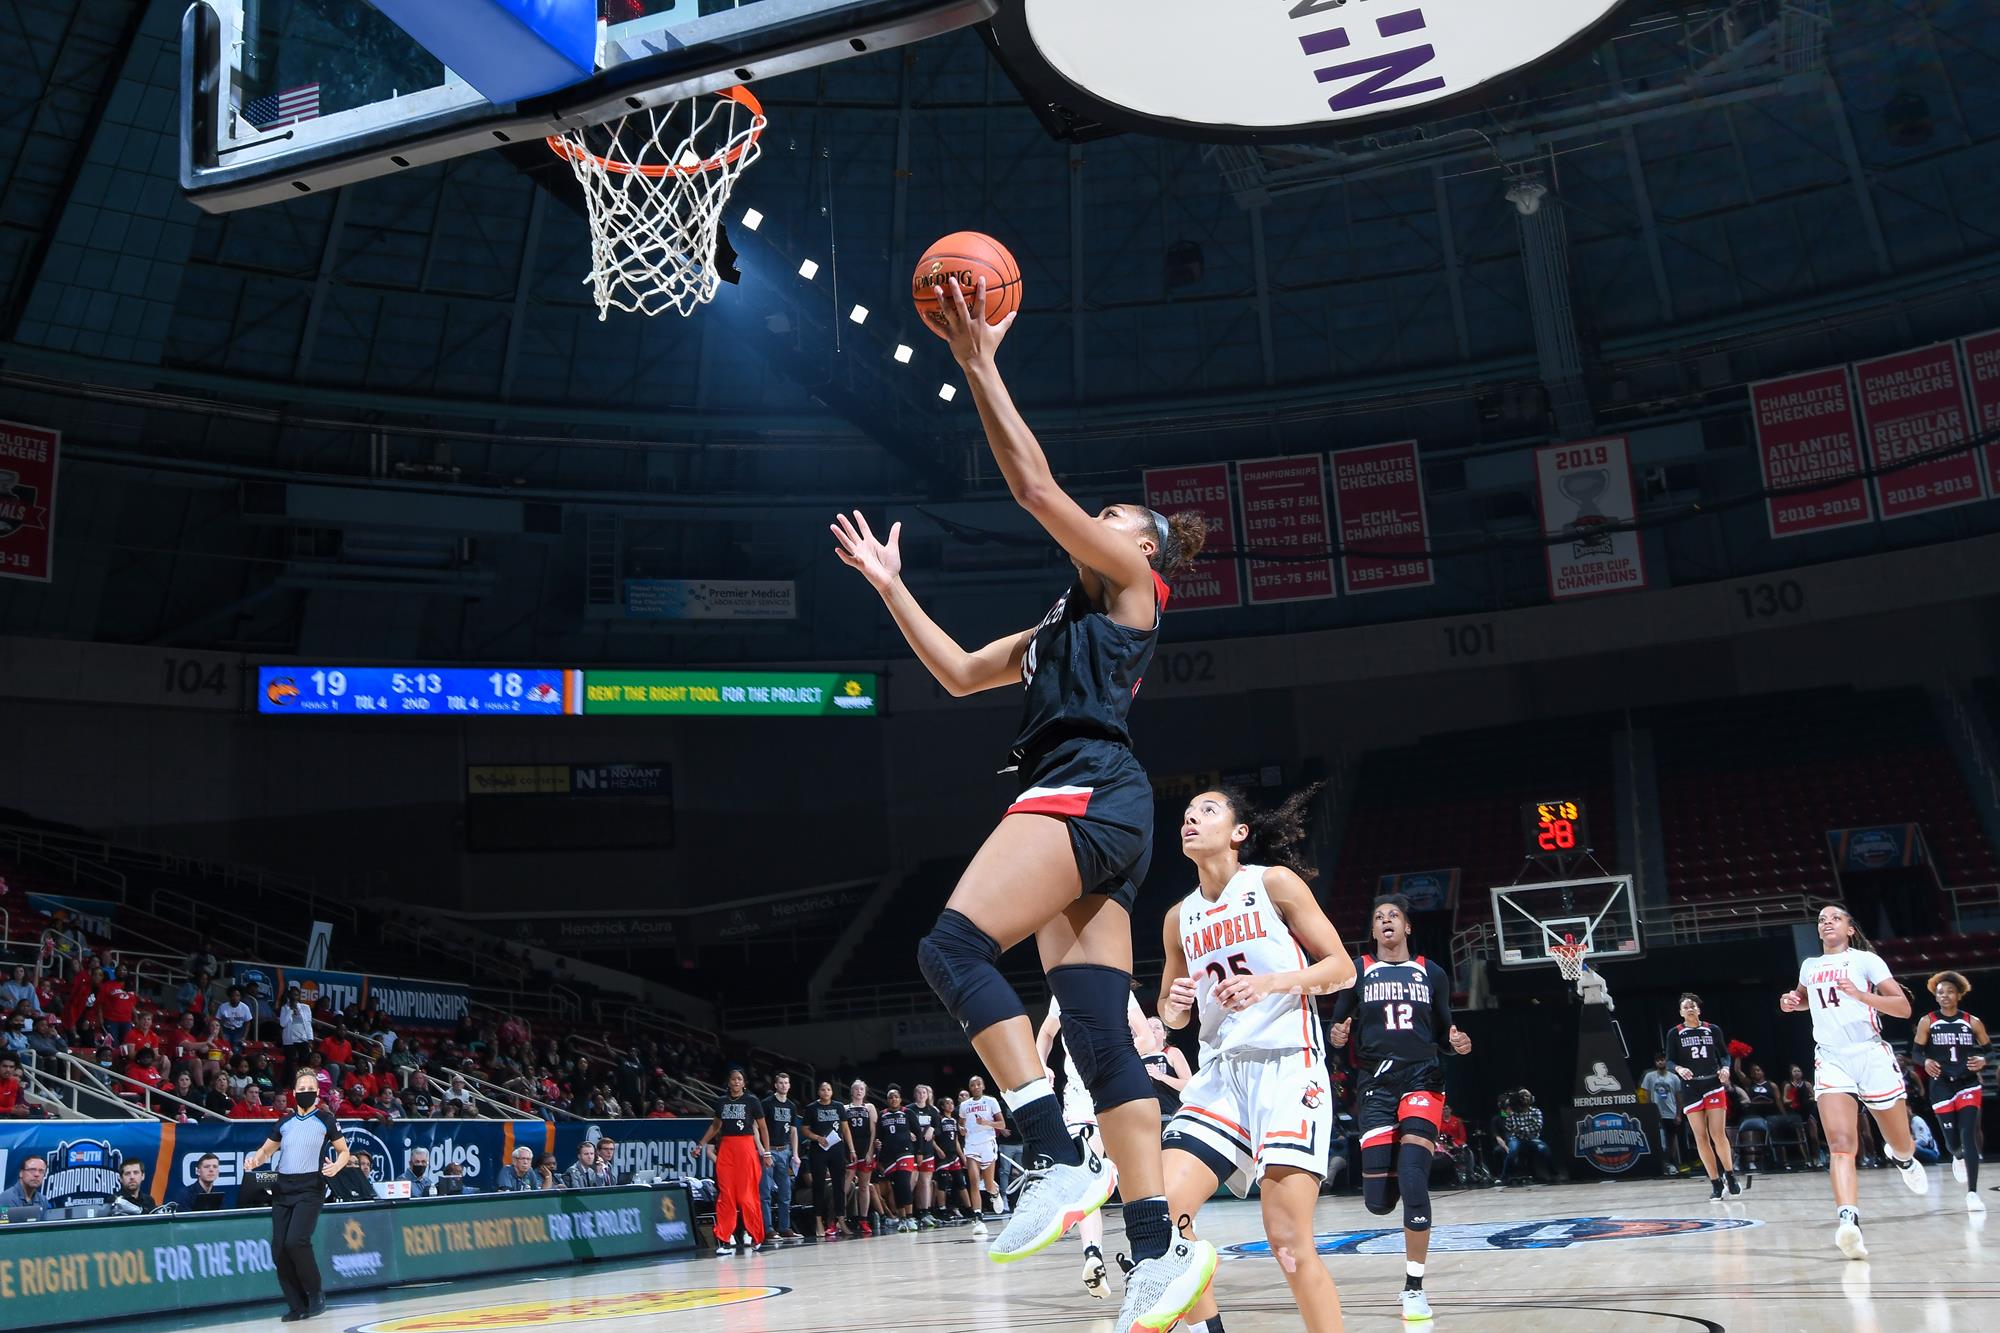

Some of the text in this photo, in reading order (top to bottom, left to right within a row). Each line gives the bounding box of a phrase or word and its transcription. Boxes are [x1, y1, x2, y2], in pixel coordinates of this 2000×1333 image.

[1865, 360, 1951, 391] CHARLOTTE
[1760, 384, 1843, 412] CHARLOTTE
[1867, 374, 1954, 406] CHECKERS
[1762, 398, 1847, 426] CHECKERS
[1874, 410, 1961, 444] REGULAR
[1768, 432, 1850, 461] ATLANTIC
[1878, 427, 1964, 462] SEASON
[1338, 457, 1413, 478] CHARLOTTE
[1556, 446, 1608, 470] 2019
[1770, 447, 1852, 477] DIVISION
[1244, 466, 1317, 481] CHAMPIONSHIPS
[1340, 471, 1415, 490] CHECKERS
[1150, 485, 1225, 506] SABATES
[1887, 475, 1974, 504] 2018-2019
[1247, 494, 1320, 512] 1956-57 EHL
[1778, 497, 1861, 524] 2018-2019
[1249, 512, 1322, 530] 1970-71 EHL
[1346, 521, 1421, 541] CHAMPIONS
[1250, 532, 1325, 549] 1971-72 EHL
[1352, 563, 1424, 582] 1995-1996
[1561, 558, 1630, 577] CALDER CUP
[1255, 574, 1300, 588] 1975-76
[1557, 569, 1638, 590] CHAMPIONS
[709, 589, 790, 598] Premier Medical
[1737, 580, 1804, 619] 130
[1444, 623, 1497, 656] 101
[163, 658, 227, 695] 104
[1158, 650, 1215, 683] 102
[311, 671, 346, 696] 19
[391, 673, 442, 694] 5:13
[489, 672, 523, 697] 18
[587, 685, 621, 701] RENT
[623, 685, 647, 701] THE
[649, 685, 688, 702] RIGHT
[690, 686, 720, 702] TOOL
[722, 686, 745, 702] FOR
[747, 687, 770, 702] THE
[771, 687, 822, 703] PROJECT
[611, 768, 662, 778] NOVANT
[611, 779, 657, 788] HEALTH
[1538, 820, 1576, 850] 28
[561, 920, 672, 936] Hendrick Acura
[1185, 911, 1267, 961] CAMPBELL
[1816, 987, 1840, 1009] 14
[1384, 1004, 1413, 1030] 12
[1691, 1046, 1708, 1059] 24
[1950, 1047, 1957, 1062] 1
[1574, 1094, 1637, 1108] HERCULES TIRES
[852, 1118, 863, 1127] 33
[890, 1125, 896, 1133] 0
[1579, 1129, 1644, 1150] CHAMPIONSHIPS
[46, 1168, 121, 1200] CHAMPIONSHIPS
[403, 1223, 441, 1256] RENT
[443, 1222, 473, 1252] THE
[473, 1219, 514, 1248] RIGHT
[513, 1216, 549, 1245] TOOL
[549, 1213, 573, 1241] FOR
[572, 1211, 597, 1239] THE
[596, 1207, 641, 1237] PROJECT
[19, 1254, 88, 1297] RIGHT
[93, 1249, 152, 1288] TOOL
[154, 1246, 195, 1283] FOR
[194, 1241, 234, 1278] THE
